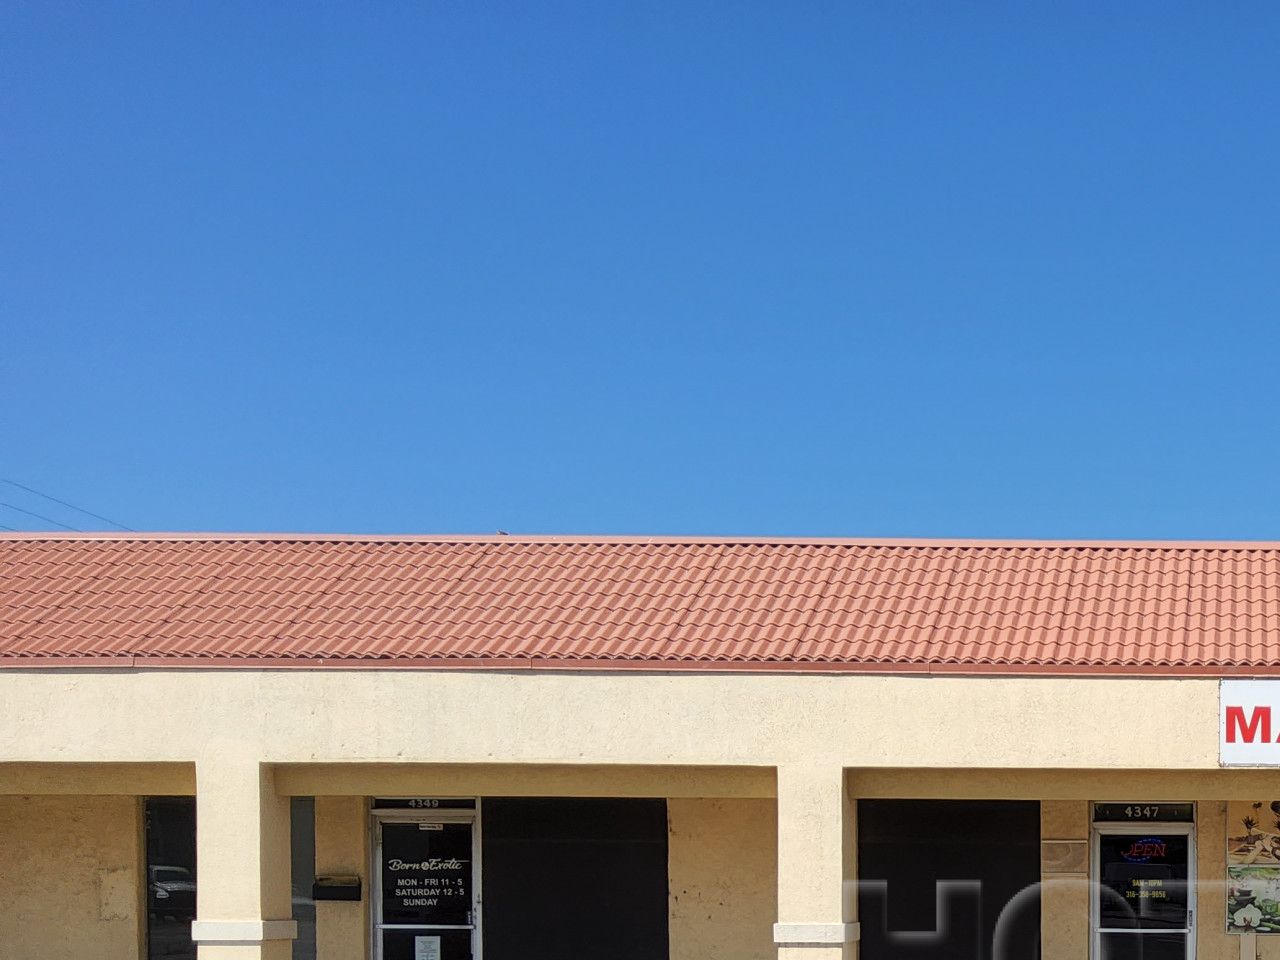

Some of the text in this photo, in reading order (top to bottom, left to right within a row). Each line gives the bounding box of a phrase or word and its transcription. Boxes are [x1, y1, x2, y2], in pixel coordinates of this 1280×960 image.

[408, 799, 439, 808] 4349
[1124, 806, 1159, 818] 4347
[388, 858, 420, 871] Born
[428, 858, 470, 871] Exotic
[397, 878, 418, 886] MON
[424, 878, 439, 886] FRI
[441, 878, 450, 886] 11
[457, 878, 463, 886] 5
[395, 888, 441, 896] SATURDAY
[443, 888, 452, 896] 12
[459, 888, 465, 896] 5
[403, 898, 438, 906] SUNDAY
